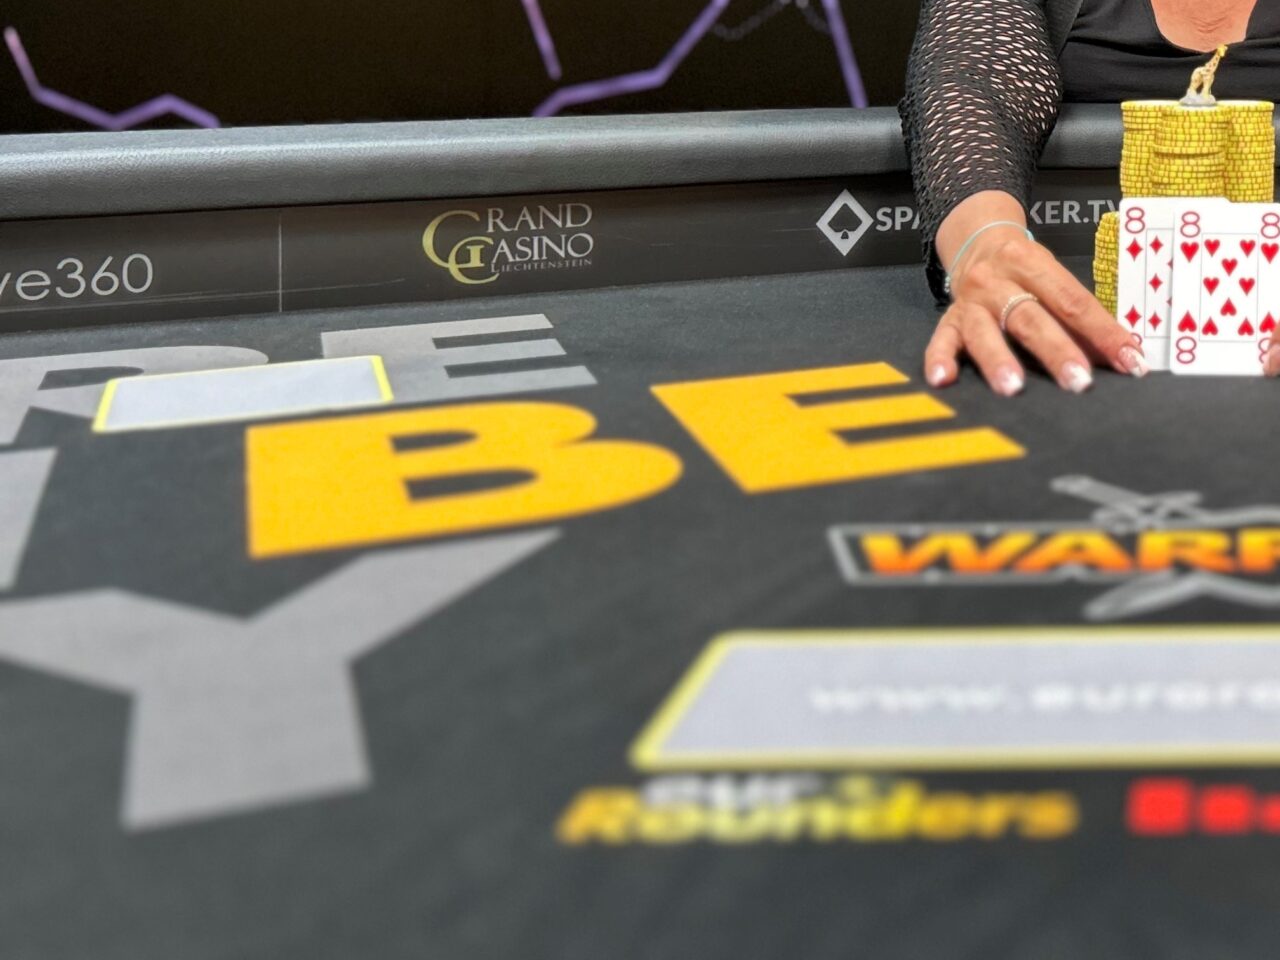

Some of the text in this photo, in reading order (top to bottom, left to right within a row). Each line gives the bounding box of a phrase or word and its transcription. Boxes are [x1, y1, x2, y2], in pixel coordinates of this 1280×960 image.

[1125, 206, 1146, 234] 8
[1180, 211, 1201, 238] 8
[1260, 212, 1280, 239] 8
[422, 202, 593, 268] GRAND
[448, 232, 594, 284] CASINO
[490, 258, 592, 273] LIECHTENSTEIN
[247, 363, 1026, 558] BE
